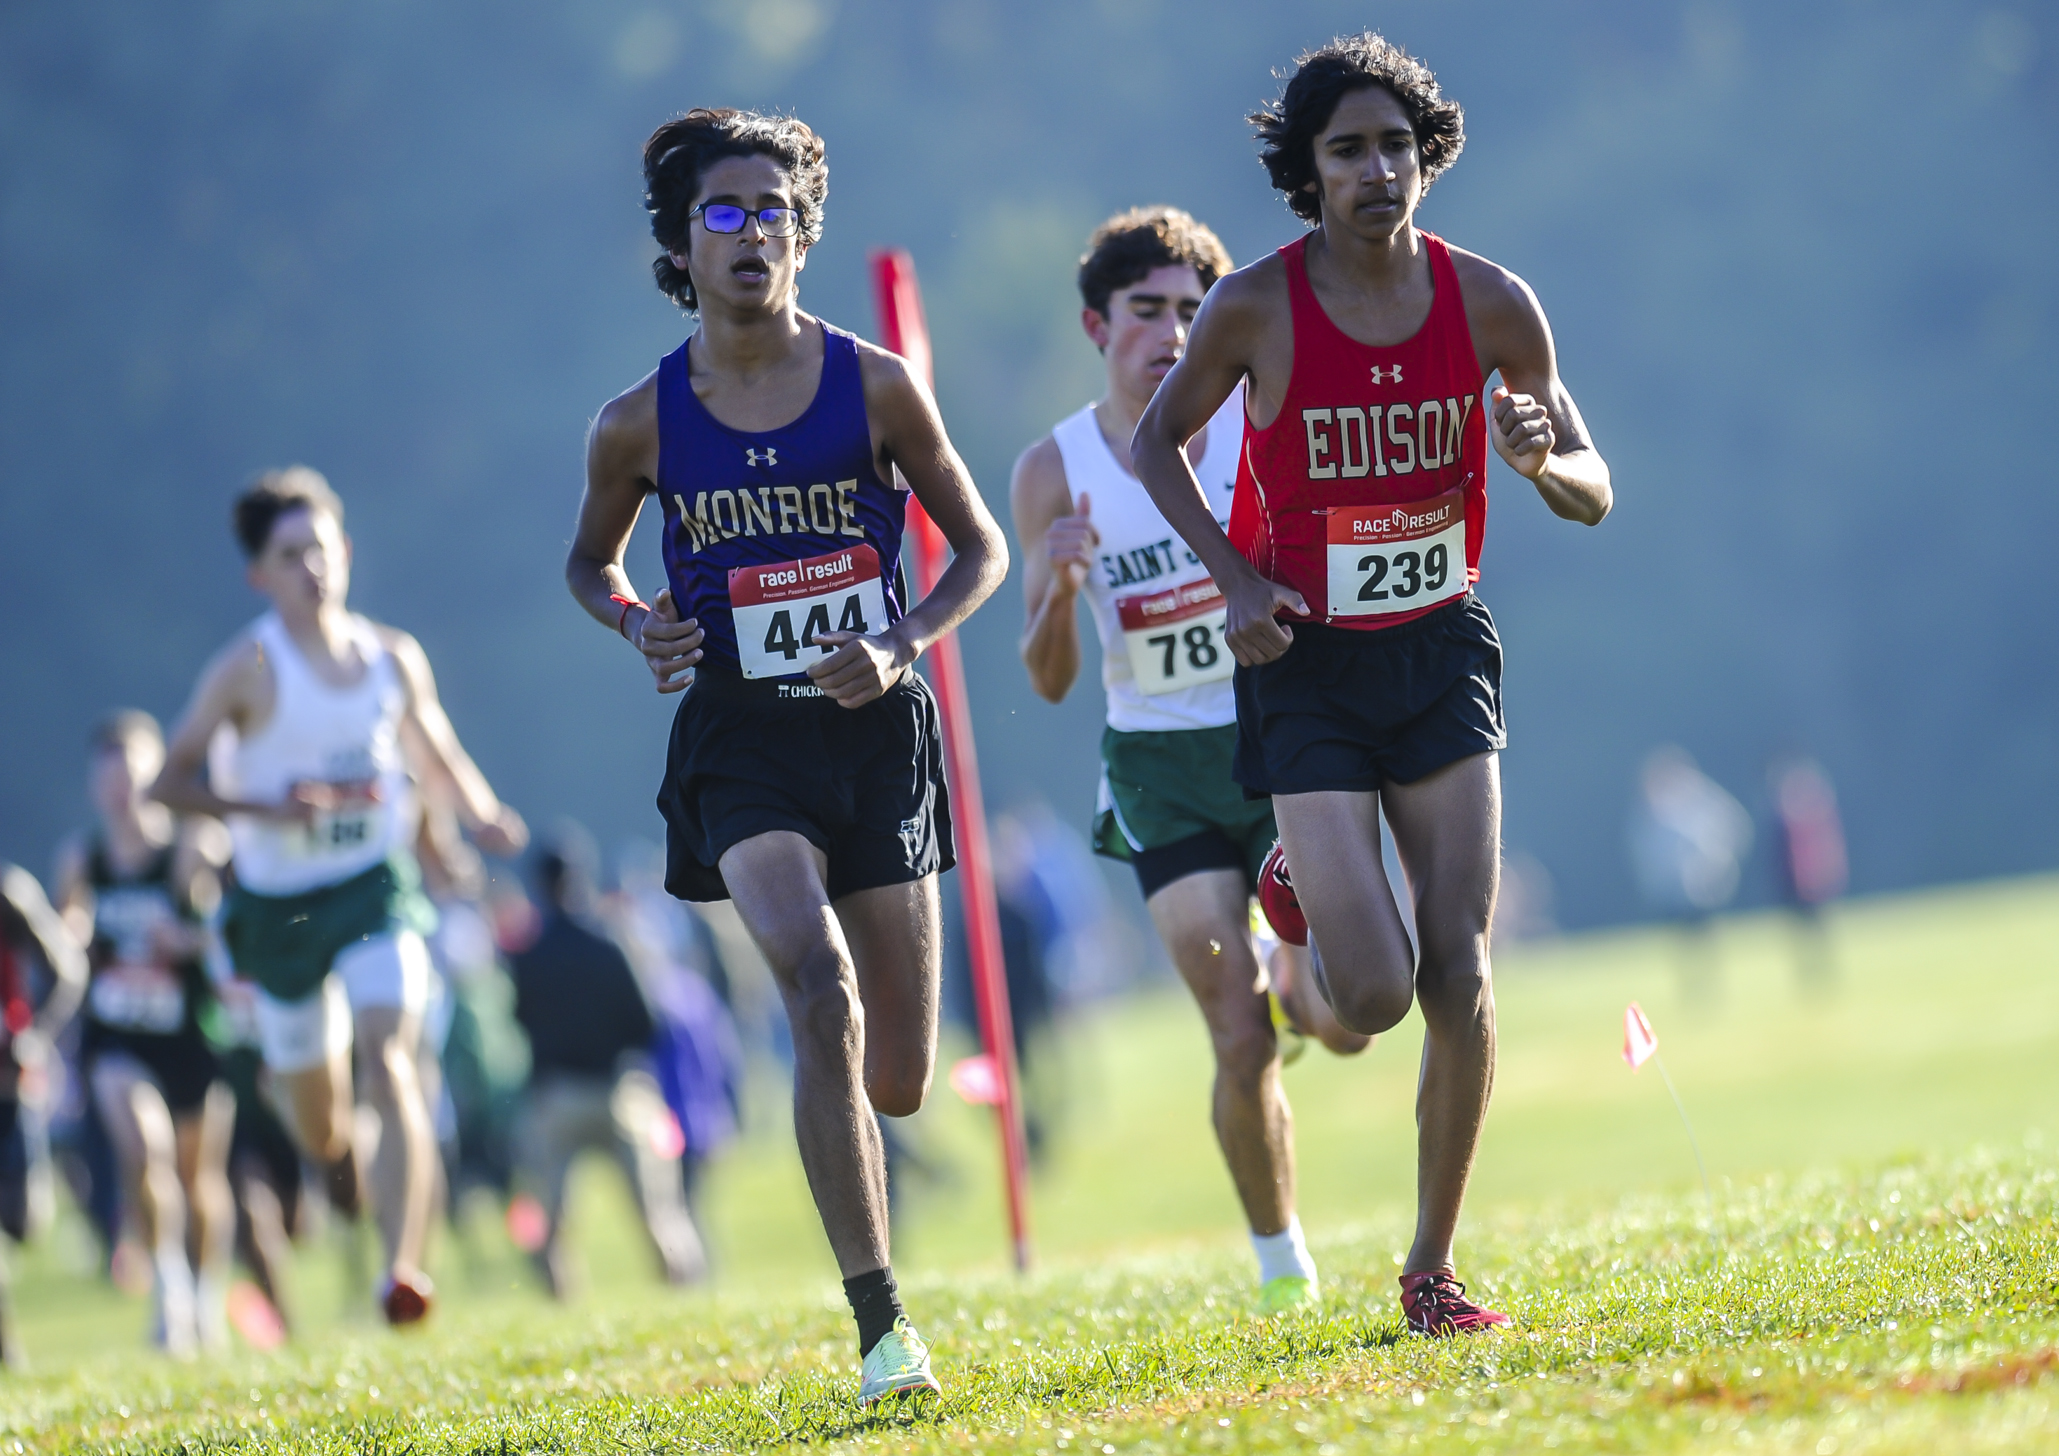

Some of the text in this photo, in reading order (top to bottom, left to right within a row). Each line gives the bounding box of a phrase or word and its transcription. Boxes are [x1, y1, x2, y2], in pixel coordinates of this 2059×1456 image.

[1301, 394, 1475, 479] EDISON
[673, 478, 865, 555] MONROE
[1353, 504, 1450, 533] RACE RESULT
[759, 554, 853, 588] race result
[1102, 539, 1177, 589] SAINT
[1356, 543, 1448, 601] 239
[763, 593, 868, 661] 444
[1148, 622, 1226, 680] 78
[791, 685, 825, 698] CHICKN
